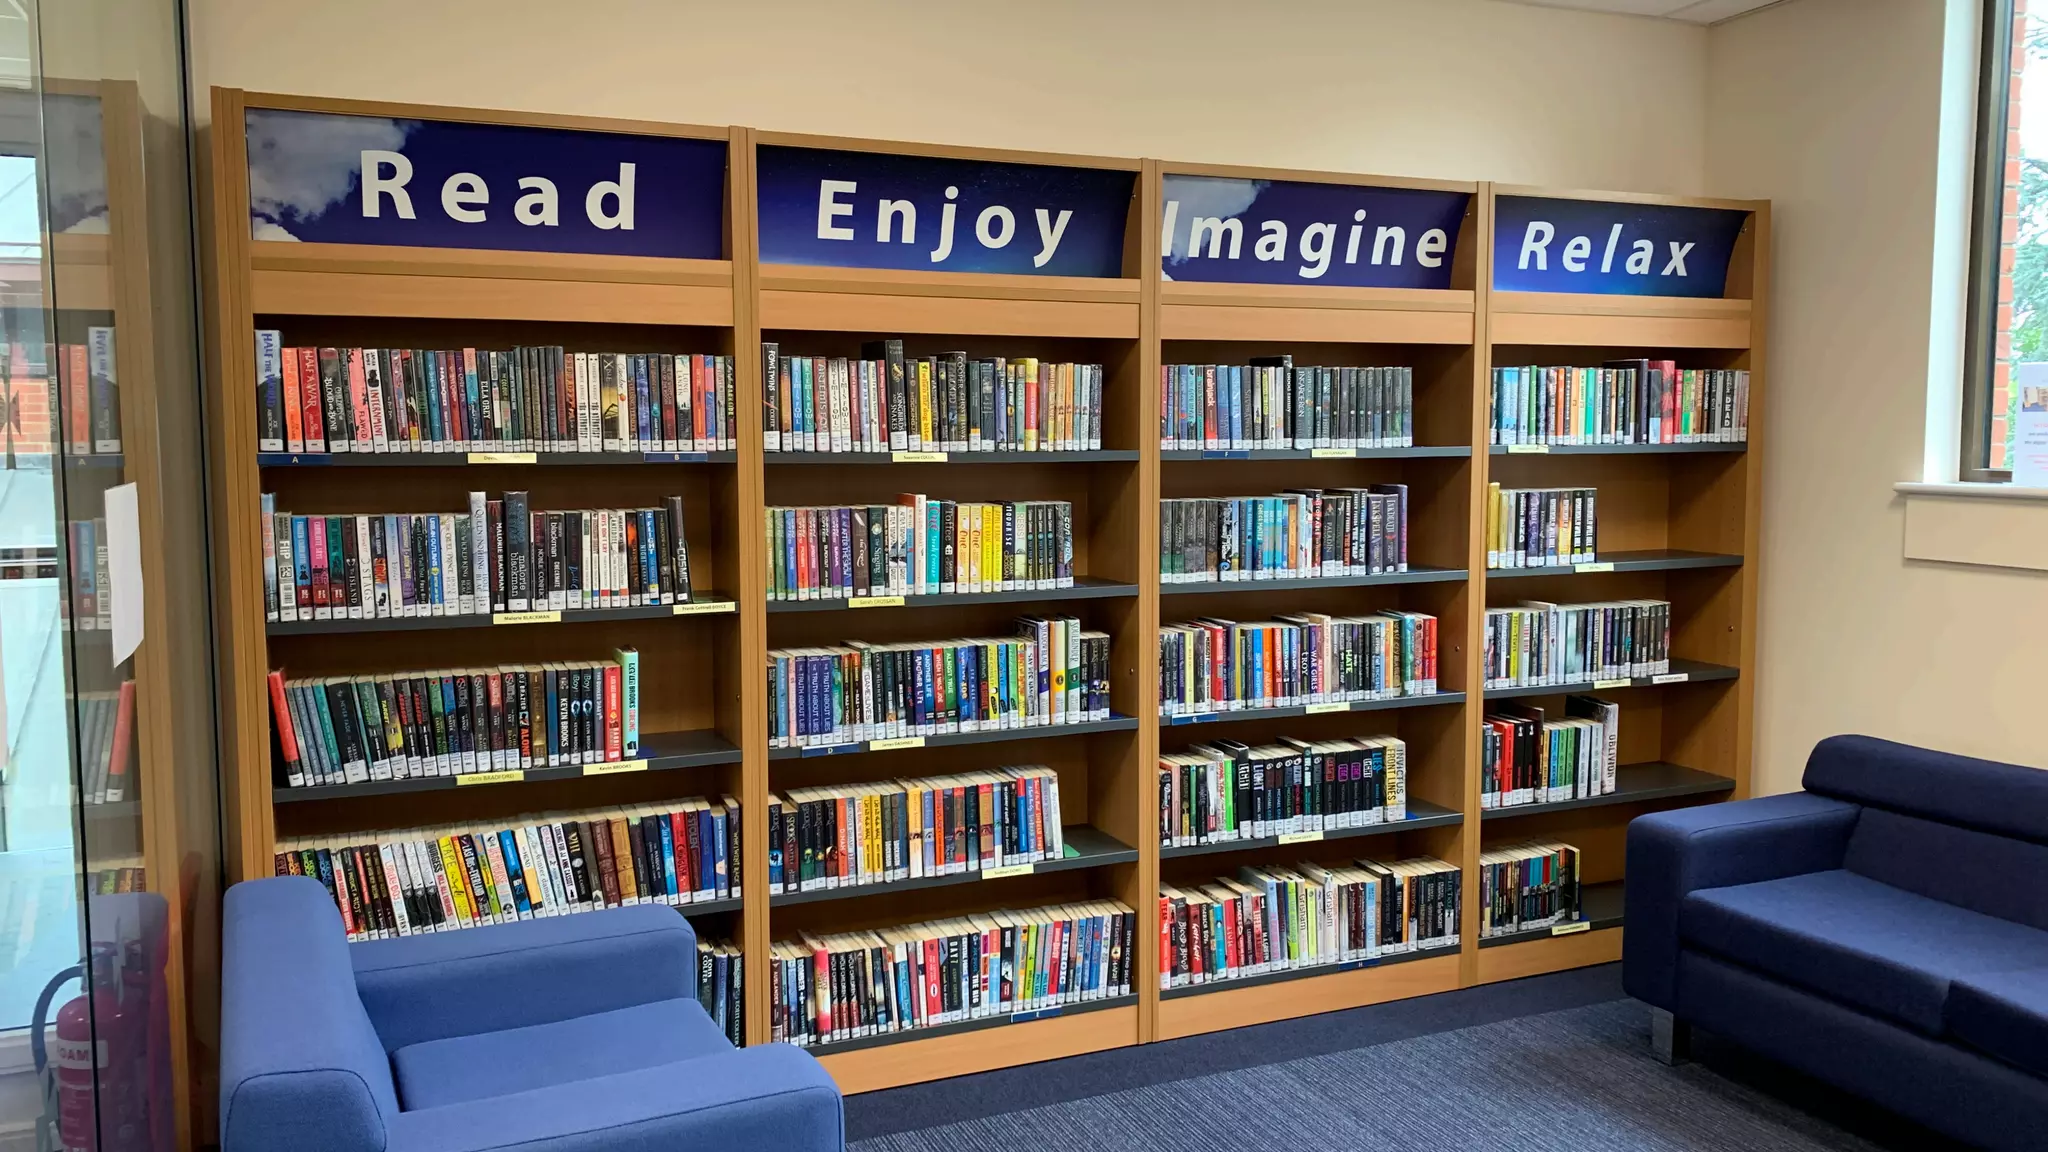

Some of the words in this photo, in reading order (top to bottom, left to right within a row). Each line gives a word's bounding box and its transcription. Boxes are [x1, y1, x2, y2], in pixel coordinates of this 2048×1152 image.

[360, 149, 637, 231] Read
[817, 178, 1074, 268] Enjoy
[1162, 200, 1448, 280] Imagine
[1517, 220, 1696, 277] Relax
[262, 334, 272, 357] HALF
[304, 350, 316, 373] HALF
[768, 350, 776, 372] FOWL
[956, 356, 964, 389] COOPER
[481, 381, 489, 401] ELLA
[768, 372, 776, 391] TWINS
[306, 384, 317, 409] WAR
[372, 389, 383, 437] INTERNMENT
[482, 402, 491, 419] GREY
[891, 404, 899, 430] SNAKES
[292, 455, 299, 464] A
[550, 522, 558, 557] blackman
[1005, 506, 1013, 546] MOONRISE
[374, 557, 386, 584] STORM
[518, 555, 526, 590] malorie
[676, 548, 689, 583] COSMIC
[873, 546, 882, 573] Singing
[510, 552, 519, 596] blackman
[503, 613, 522, 622] Malorie
[523, 613, 551, 622] BLACKMAN
[1039, 624, 1048, 670] SHADOWBLACK
[1069, 622, 1079, 662] SOULBINDER
[381, 700, 390, 724] TARGET
[560, 698, 568, 719] KEVIN
[521, 728, 530, 757] ALONE
[561, 720, 569, 747] BROOKS
[1372, 752, 1382, 771] LIES
[1387, 749, 1396, 775] FRONT
[1607, 734, 1616, 778] OBLIVION
[1253, 764, 1264, 791] LIGHT
[1388, 777, 1396, 801] LINES
[429, 844, 442, 872] BURGESS
[441, 842, 454, 867] TAPE
[462, 846, 472, 856] LAST
[1299, 894, 1308, 930] Grisham
[1325, 890, 1334, 927] Grisham
[949, 942, 958, 959] DAY
[1060, 931, 1070, 984] HEROIC
[797, 959, 806, 990] BOMBER
